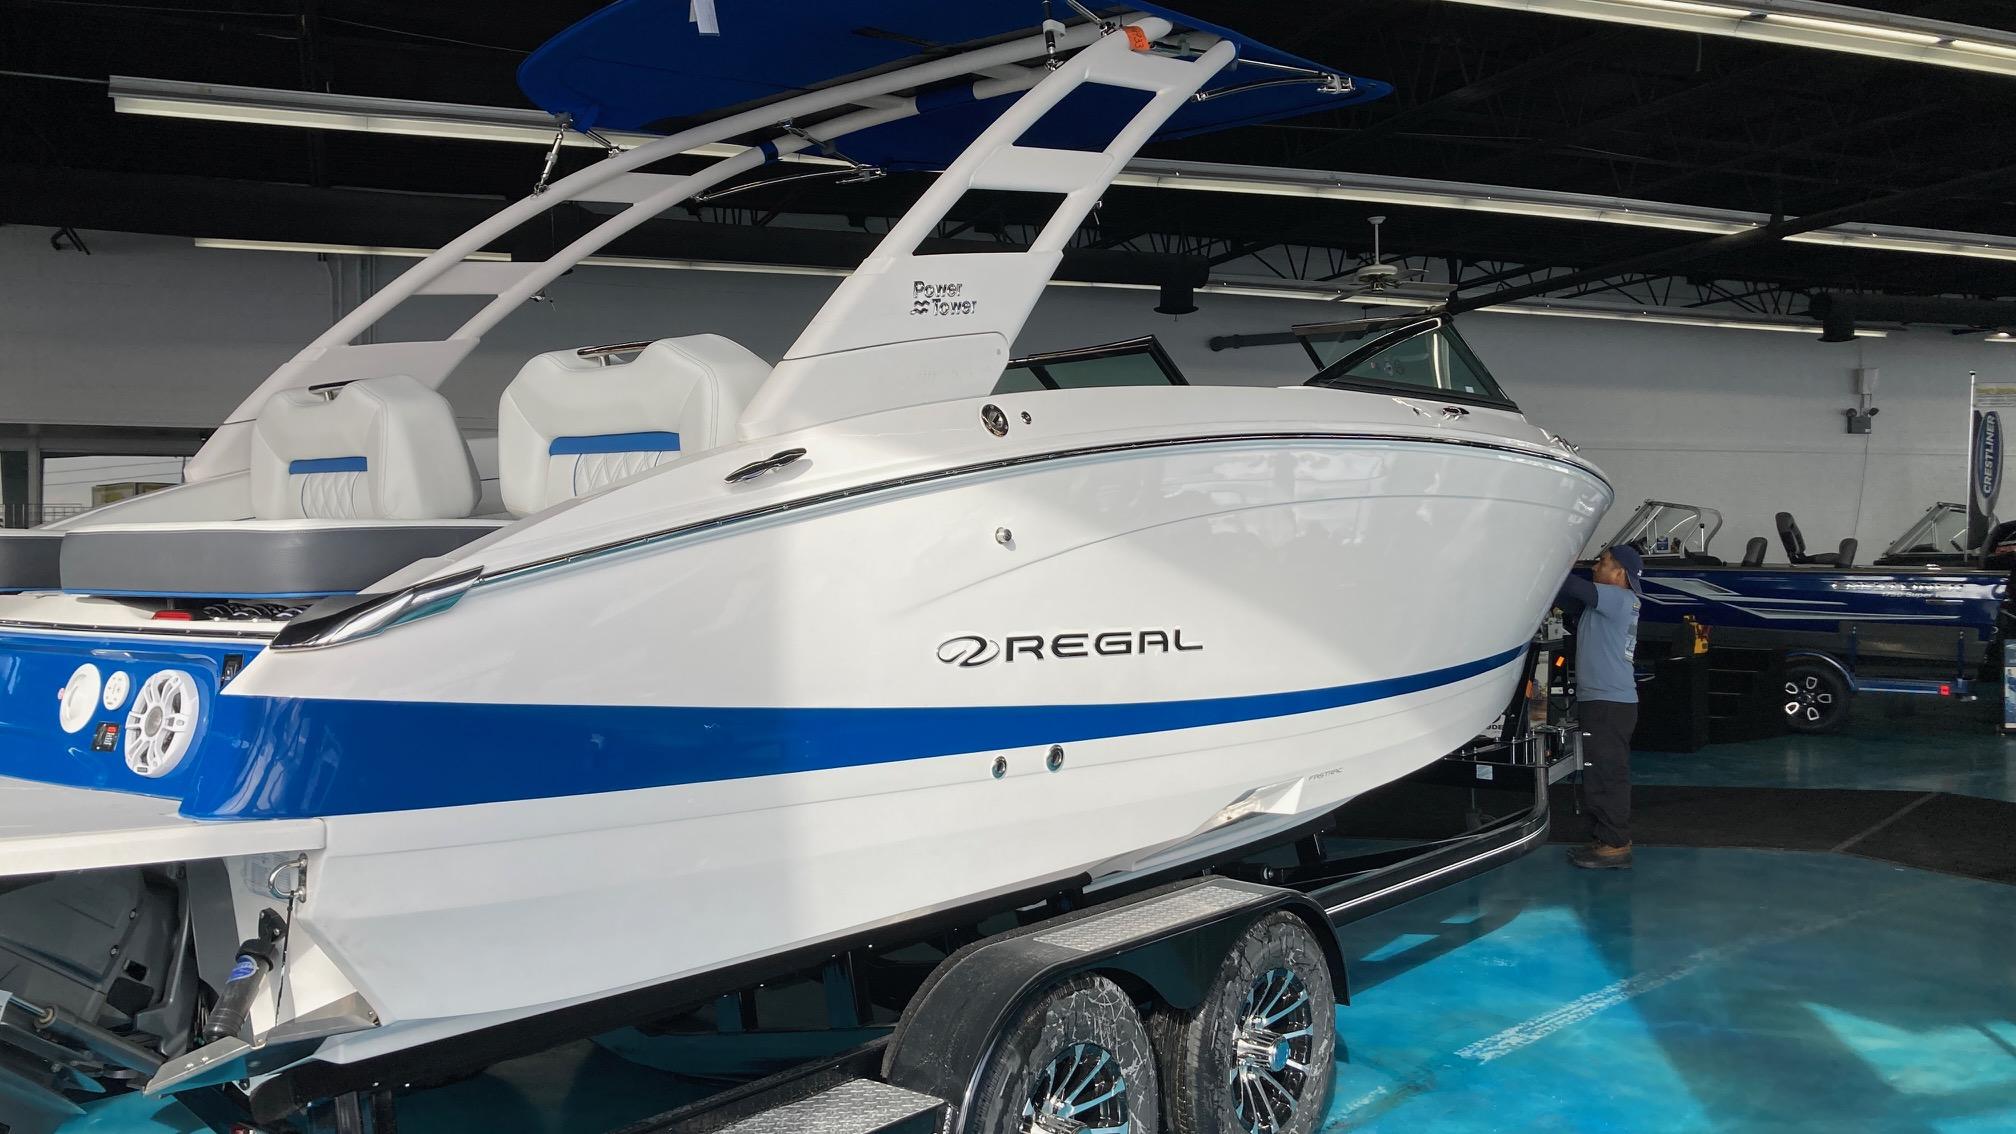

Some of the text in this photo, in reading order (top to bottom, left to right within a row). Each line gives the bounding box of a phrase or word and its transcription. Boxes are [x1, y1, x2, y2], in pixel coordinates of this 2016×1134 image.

[913, 281, 963, 298] Power
[932, 299, 977, 316] Tower
[1983, 415, 1996, 494] CRESTLINER
[1005, 629, 1204, 662] REGAL
